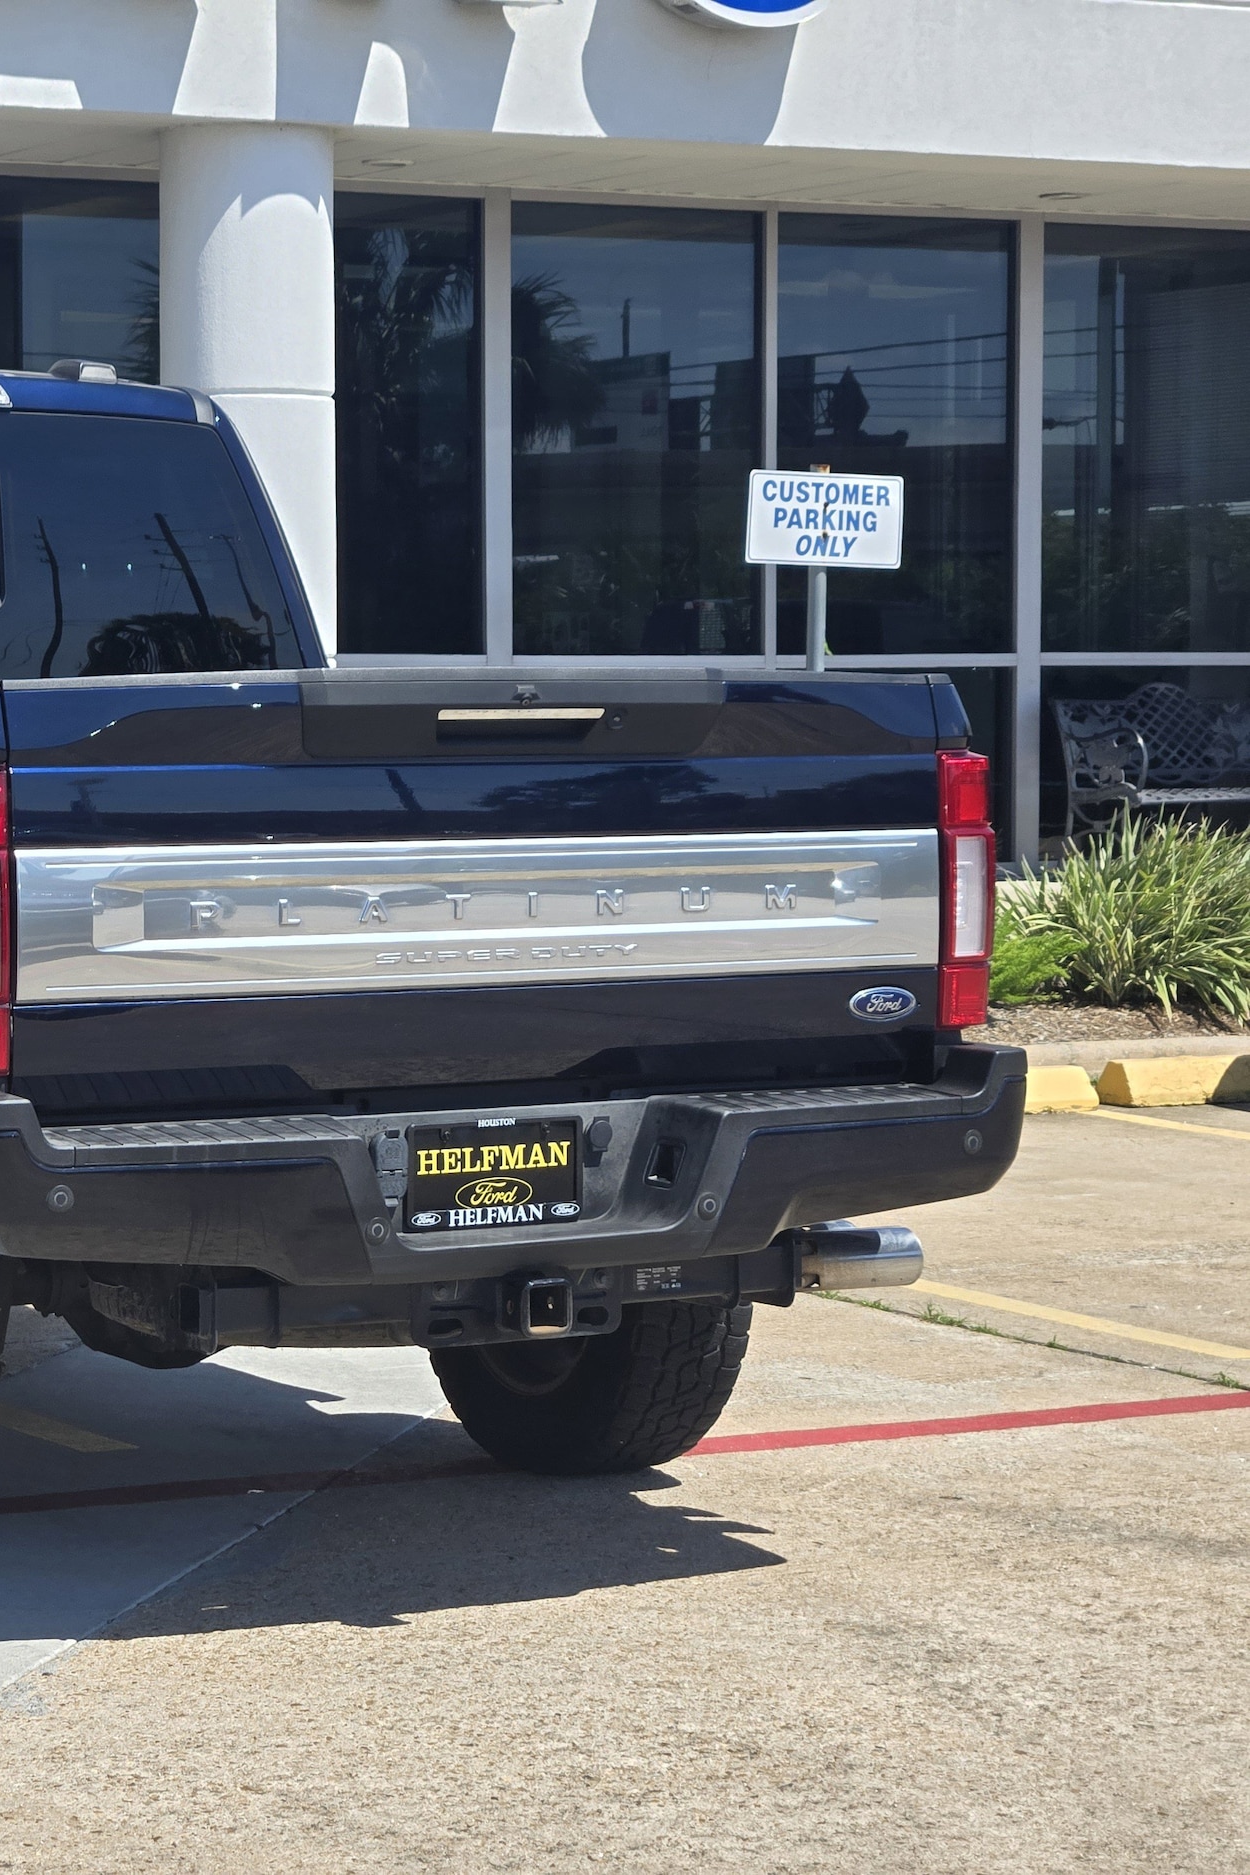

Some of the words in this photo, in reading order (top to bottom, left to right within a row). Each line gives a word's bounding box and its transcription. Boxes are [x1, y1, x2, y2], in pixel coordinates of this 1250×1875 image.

[762, 479, 890, 506] CUSTOMER
[773, 507, 877, 532] PARKING
[795, 534, 858, 558] ONLY
[188, 883, 797, 930] PLATINUM
[375, 948, 520, 965] SUPER
[531, 943, 638, 960] DUTY
[866, 993, 903, 1013] Ford
[477, 1118, 516, 1127] HOUSTON
[417, 1141, 571, 1175] HELFMAN
[469, 1181, 518, 1206] Ford
[448, 1203, 544, 1227] HELFMAN
